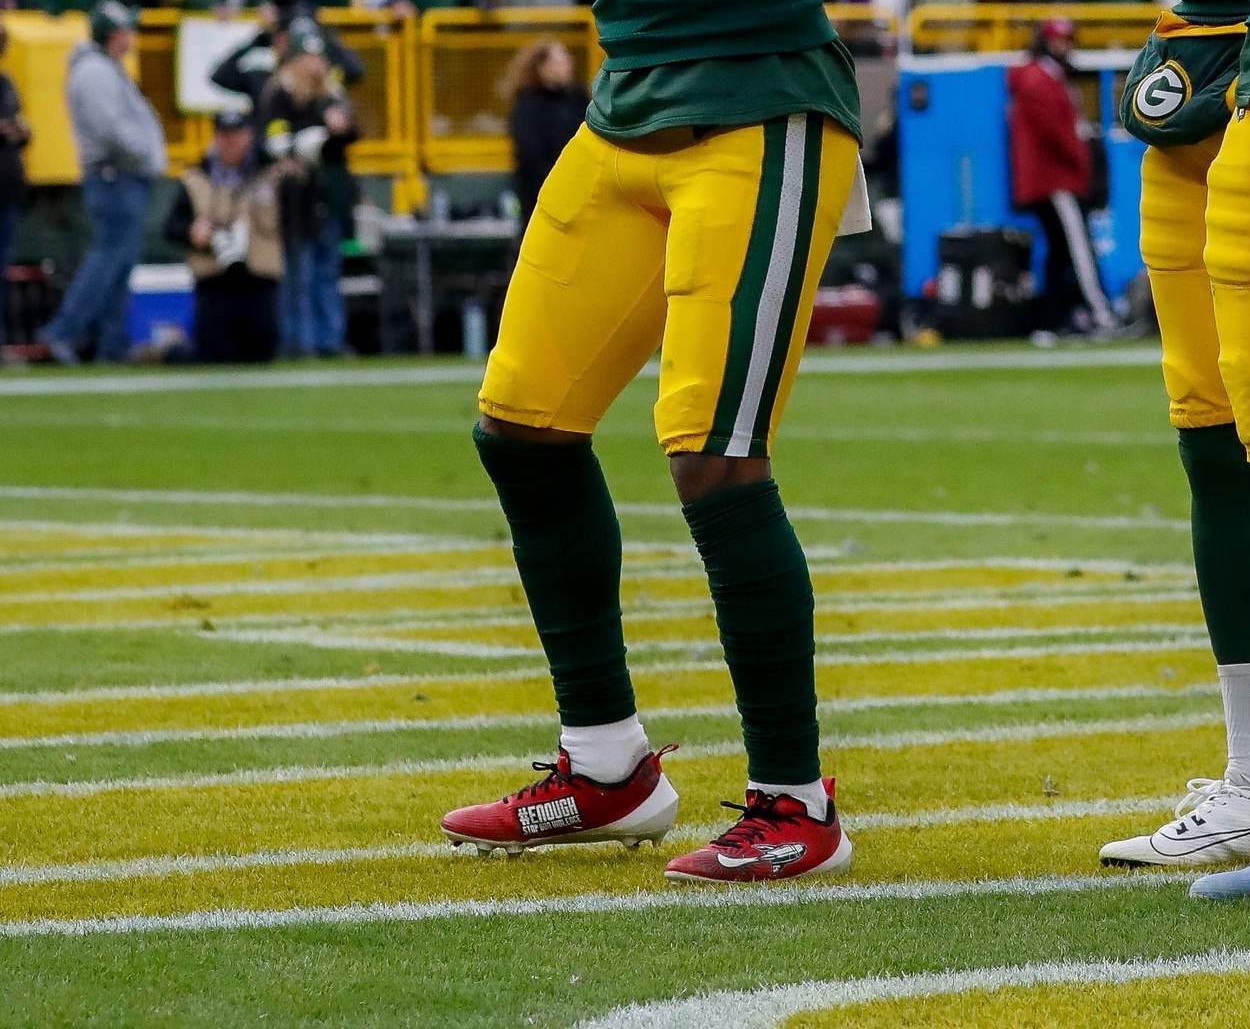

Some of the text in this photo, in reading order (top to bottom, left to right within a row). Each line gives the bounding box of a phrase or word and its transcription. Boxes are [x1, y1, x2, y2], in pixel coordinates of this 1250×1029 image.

[1136, 68, 1184, 117] G
[517, 796, 579, 826] #ENOUGH
[522, 824, 539, 835] STOP
